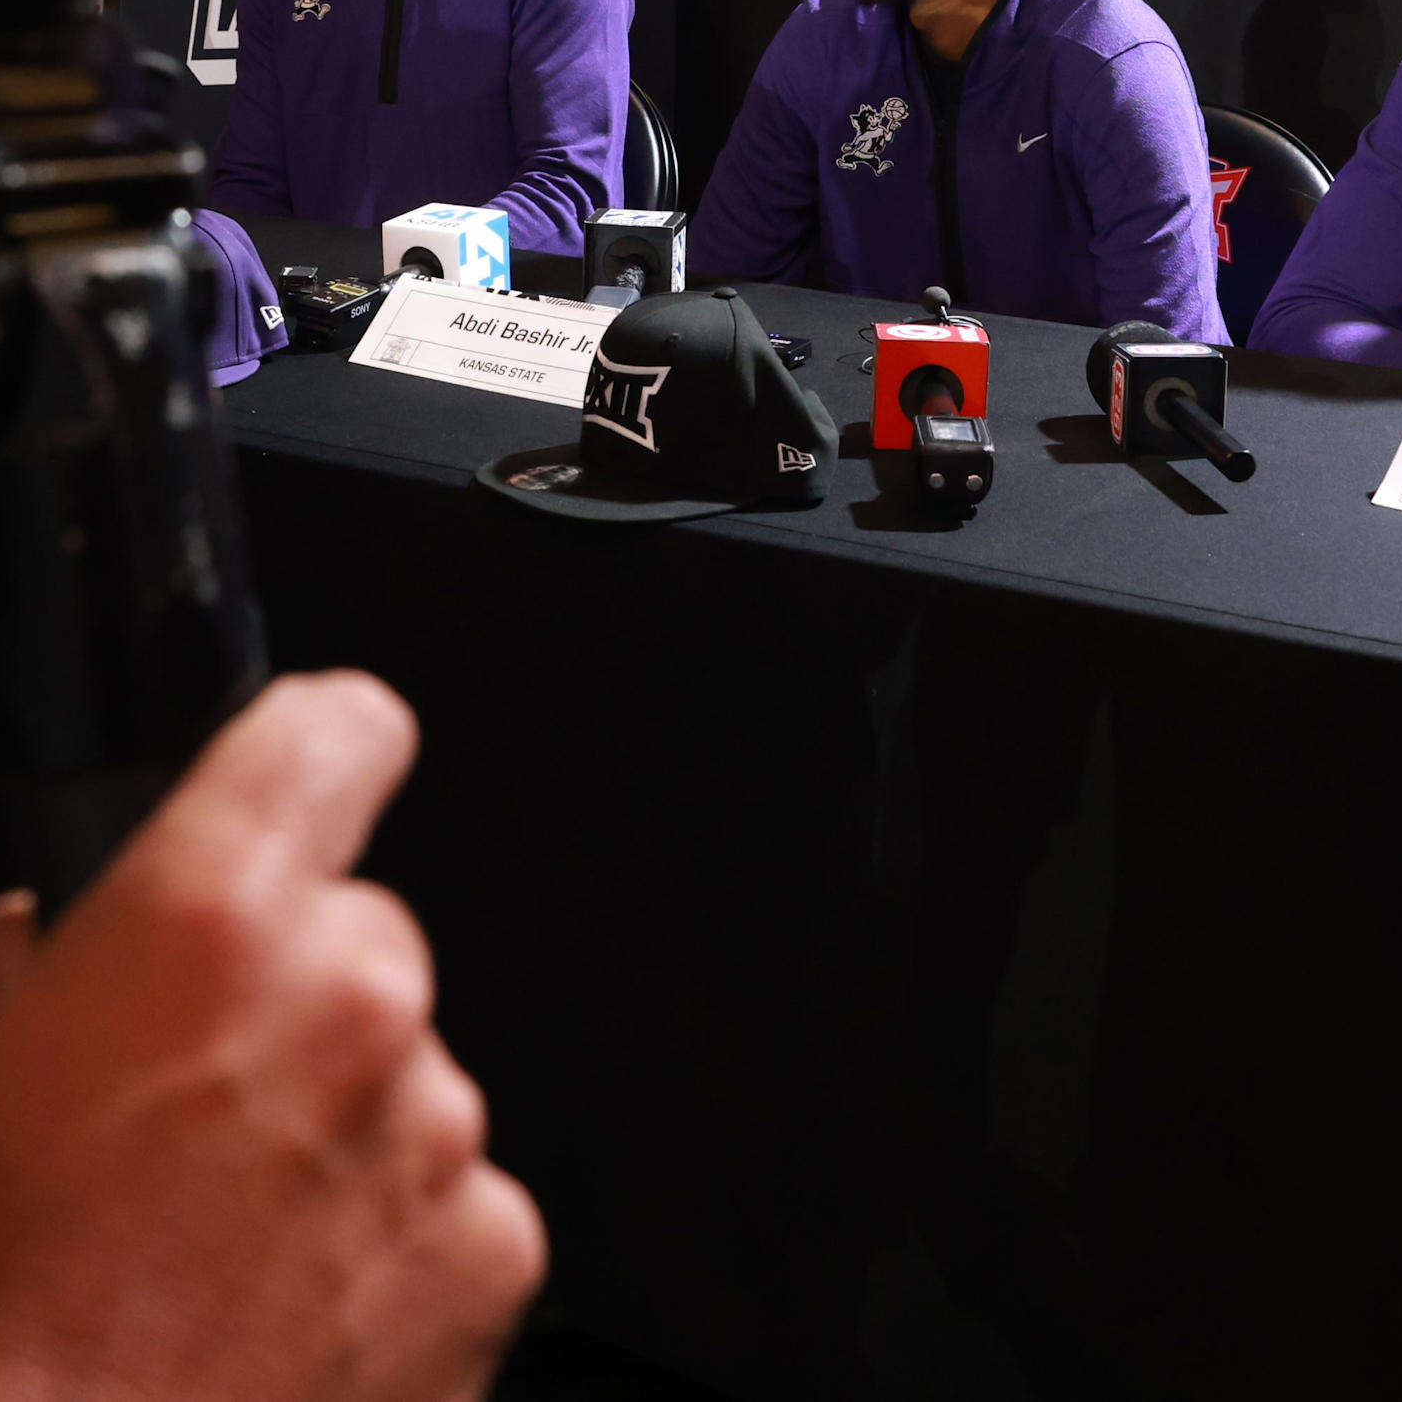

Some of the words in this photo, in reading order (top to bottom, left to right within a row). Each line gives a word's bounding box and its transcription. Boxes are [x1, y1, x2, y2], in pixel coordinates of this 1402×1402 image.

[350, 301, 371, 318] SONY
[449, 312, 500, 336] Abdi
[500, 321, 570, 350] Bashir
[571, 335, 594, 354] Jr.
[458, 357, 507, 376] KANSAS
[507, 367, 547, 383] STATE
